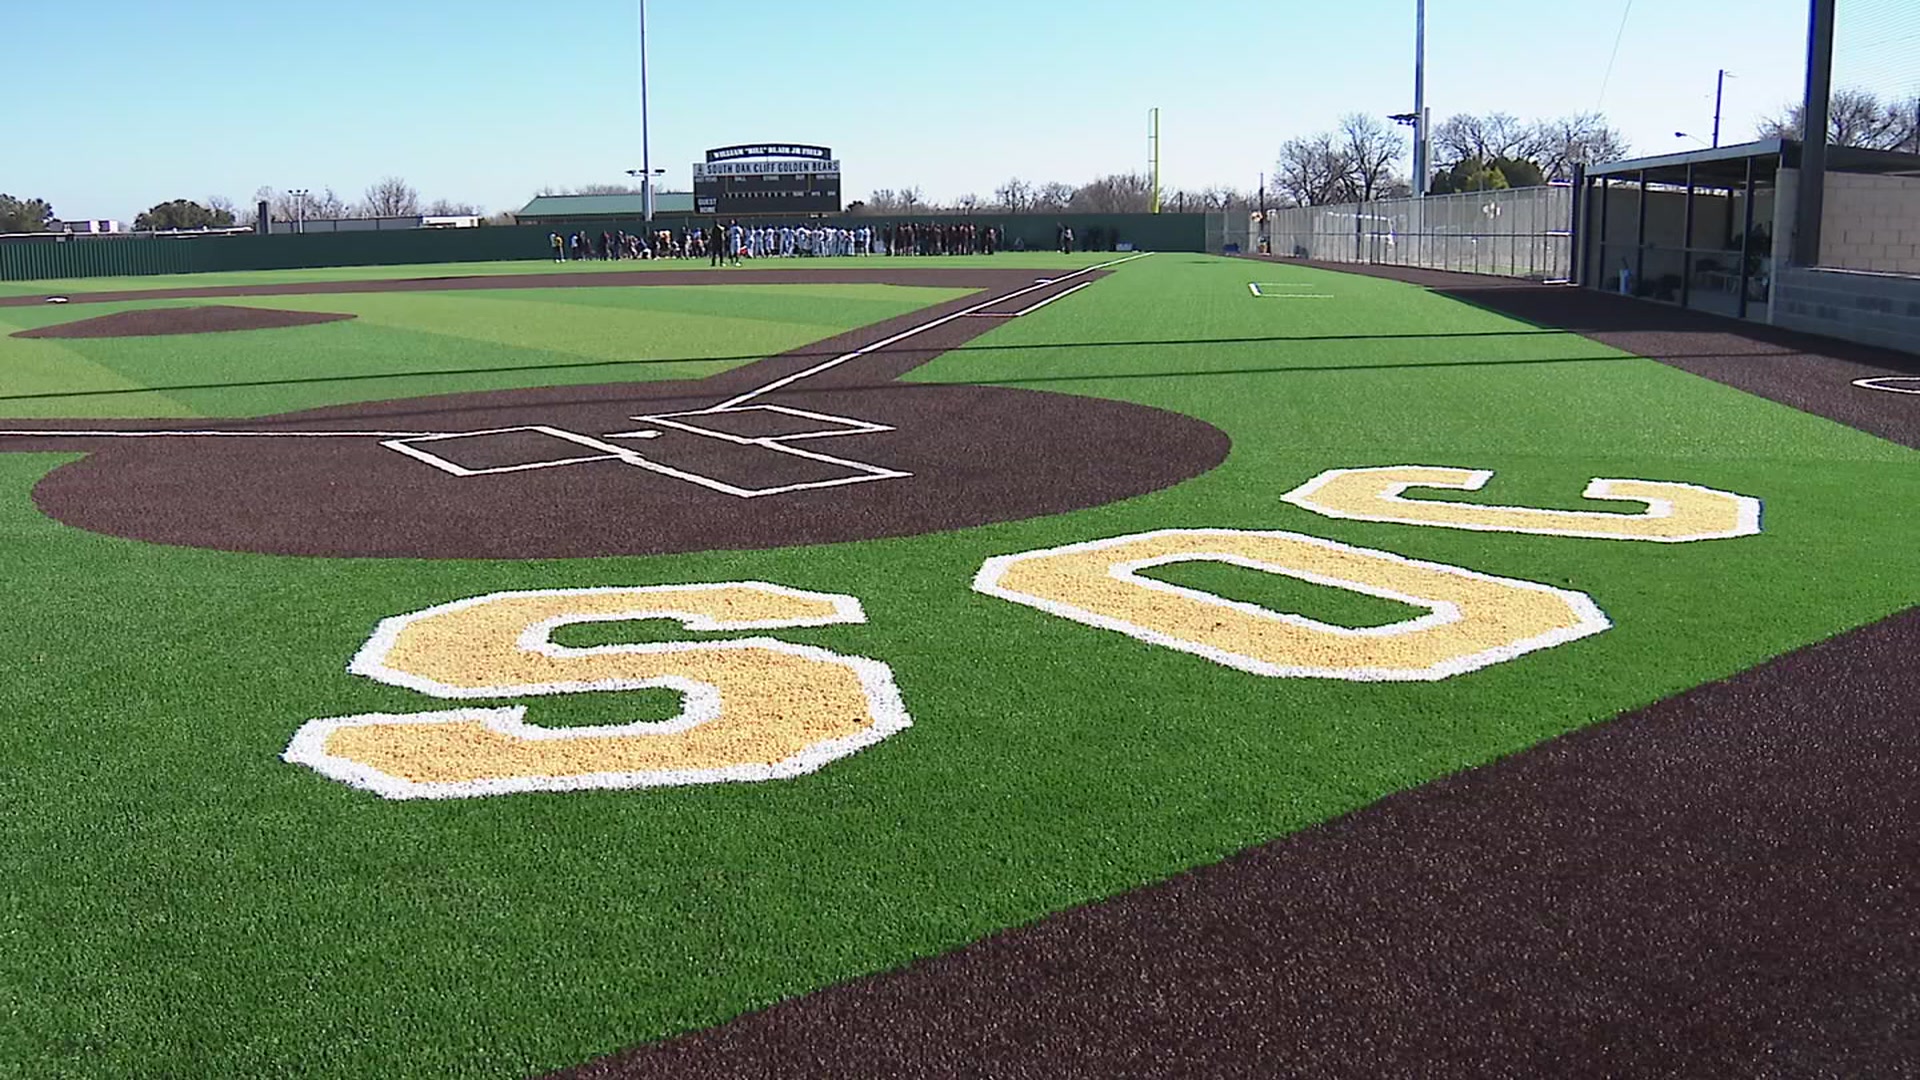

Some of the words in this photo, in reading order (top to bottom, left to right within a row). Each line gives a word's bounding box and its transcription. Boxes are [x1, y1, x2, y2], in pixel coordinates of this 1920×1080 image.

[707, 164, 733, 175] SOUTH
[735, 163, 752, 174] OAK
[753, 162, 776, 173] CLIFF
[778, 162, 809, 173] GOLDEN
[812, 161, 839, 172] BEARS
